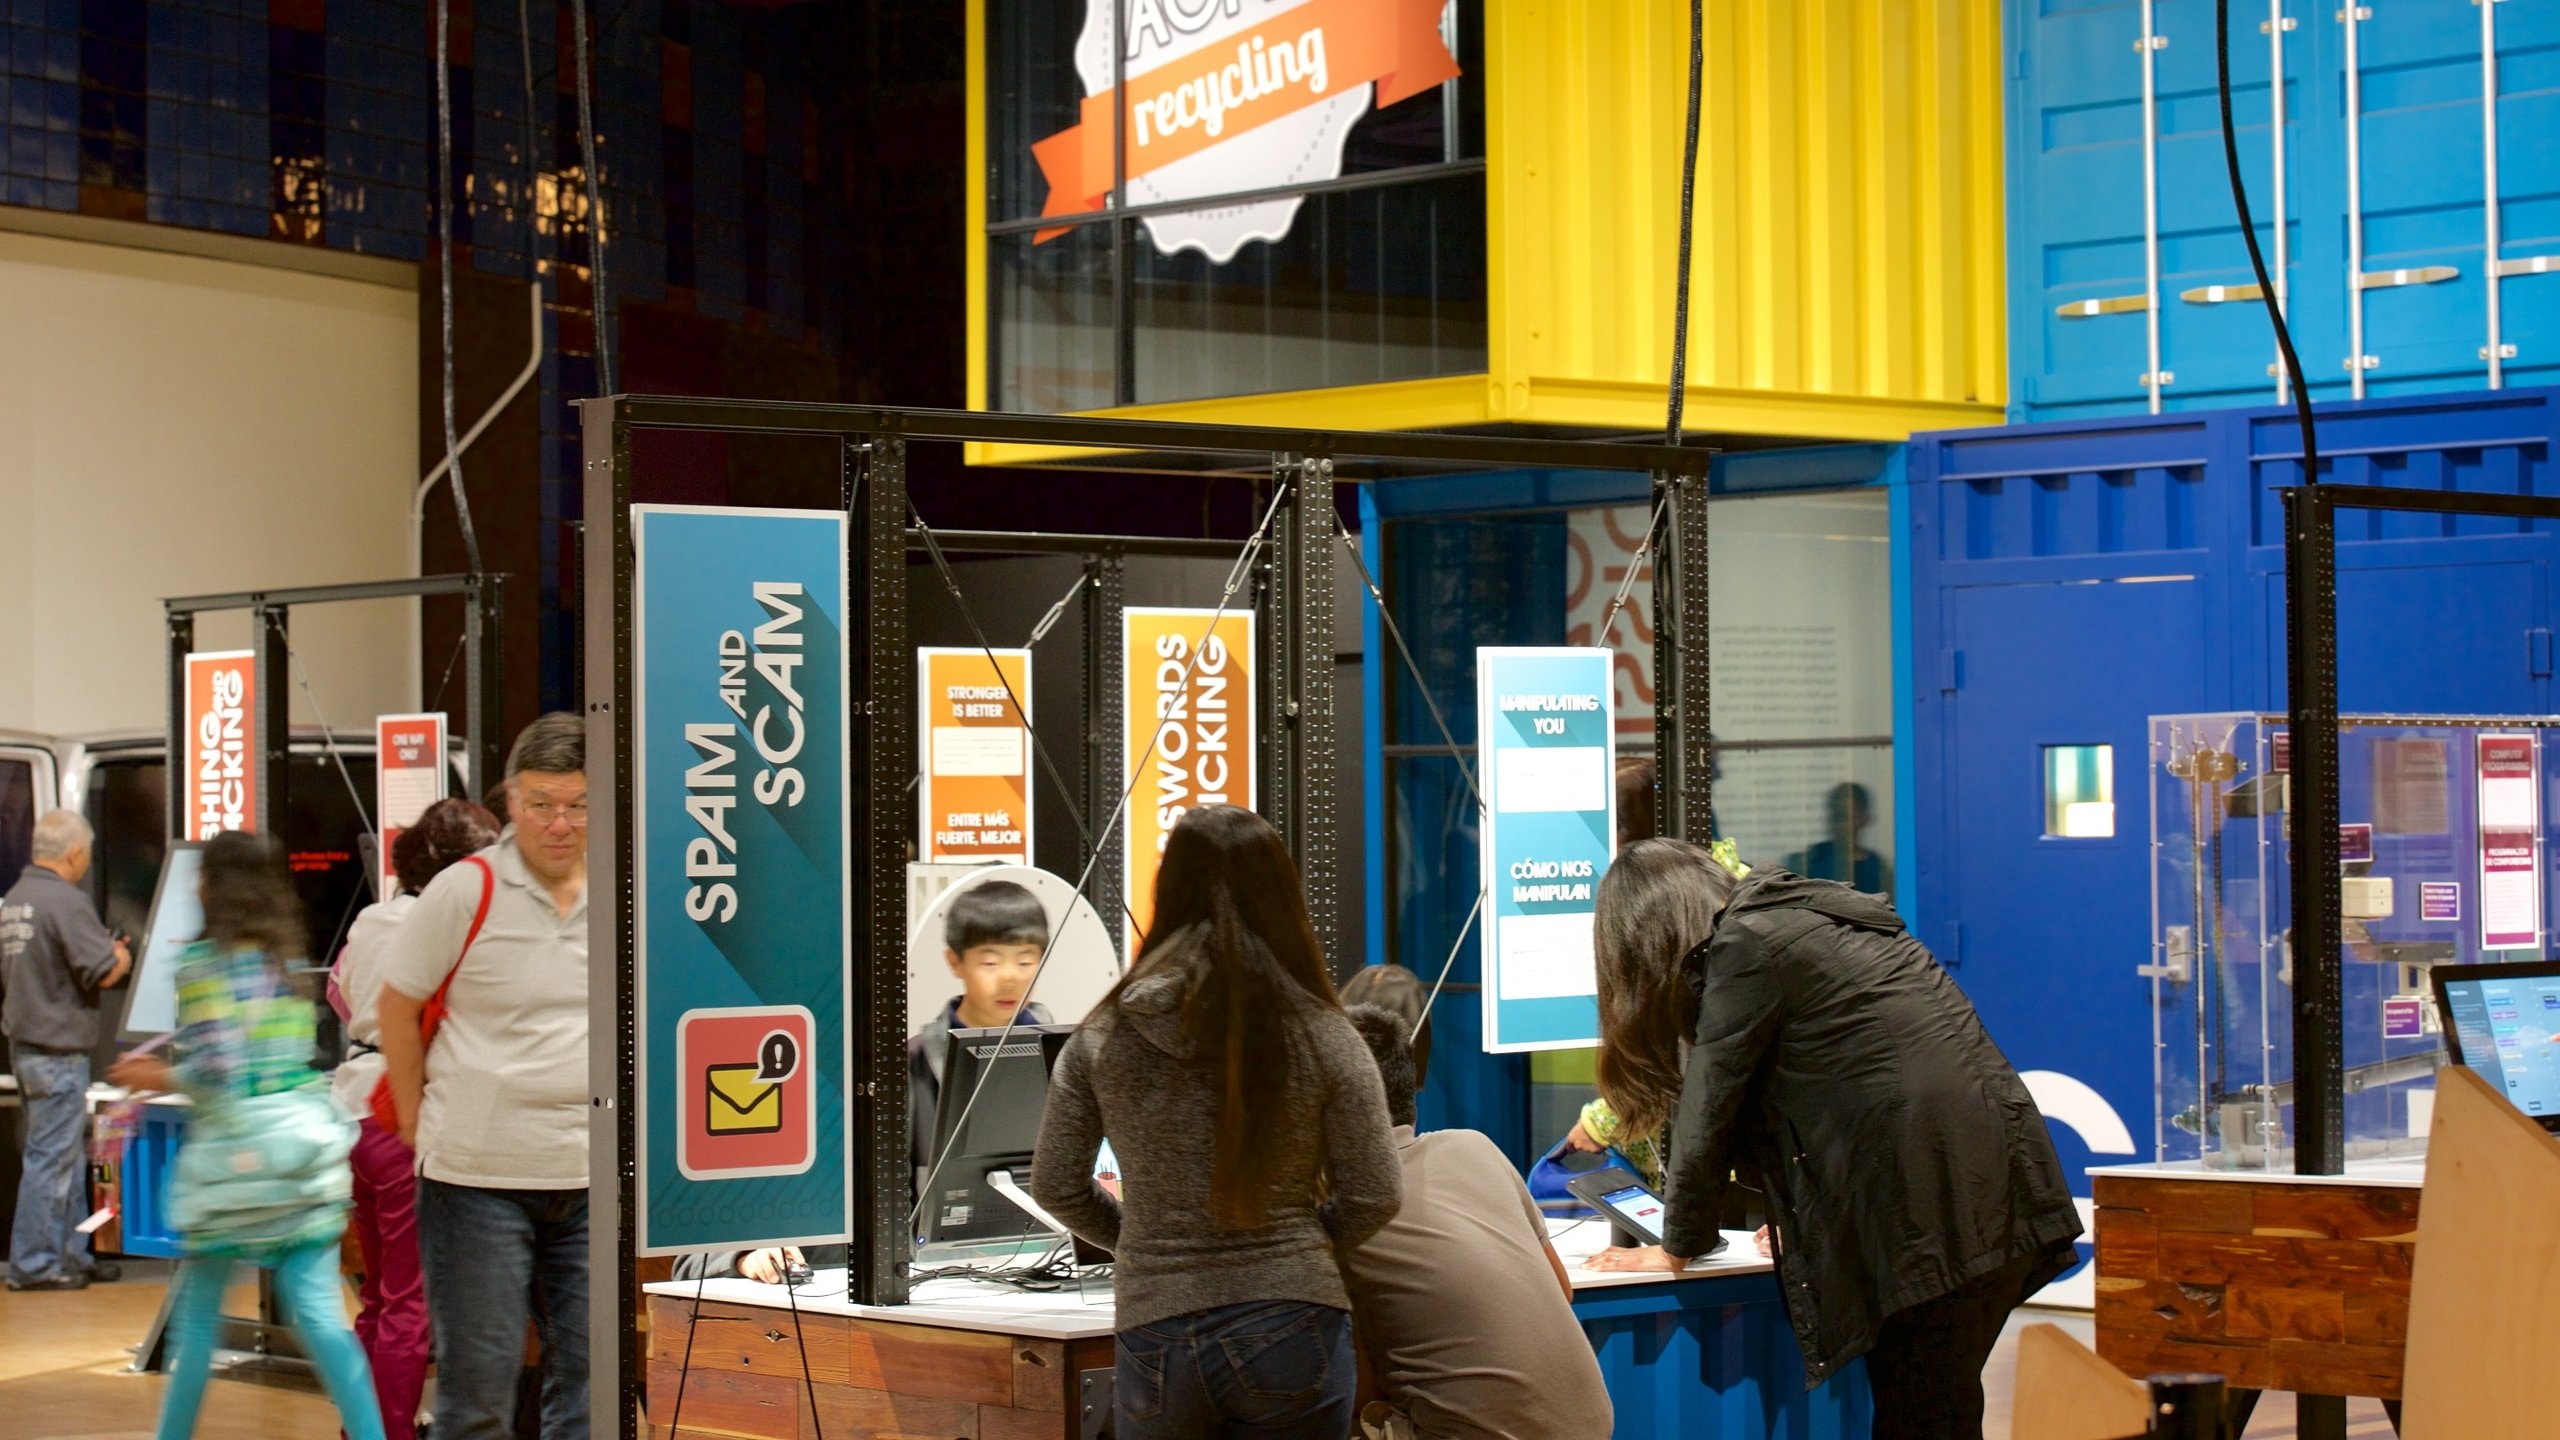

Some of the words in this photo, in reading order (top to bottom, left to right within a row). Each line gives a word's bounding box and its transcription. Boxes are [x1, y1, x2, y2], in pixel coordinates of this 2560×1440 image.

[1133, 27, 1328, 146] recycling
[719, 630, 747, 719] AND
[213, 670, 225, 718] AND
[753, 582, 805, 807] SCAM
[946, 685, 1009, 700] STRONGER
[952, 704, 964, 717] IS
[966, 704, 1003, 717] BETTER
[1500, 694, 1599, 712] MANIPULATING
[1533, 718, 1566, 734] YOU
[685, 723, 738, 923] SPAM
[947, 813, 983, 827] ENTRE
[984, 809, 1010, 826] MÁS
[936, 831, 979, 846] FUERTE,
[980, 830, 1021, 845] MEJOR
[1510, 857, 1559, 880] CÓMO
[1561, 860, 1593, 878] NOS
[1512, 883, 1591, 903] MANIPULAN
